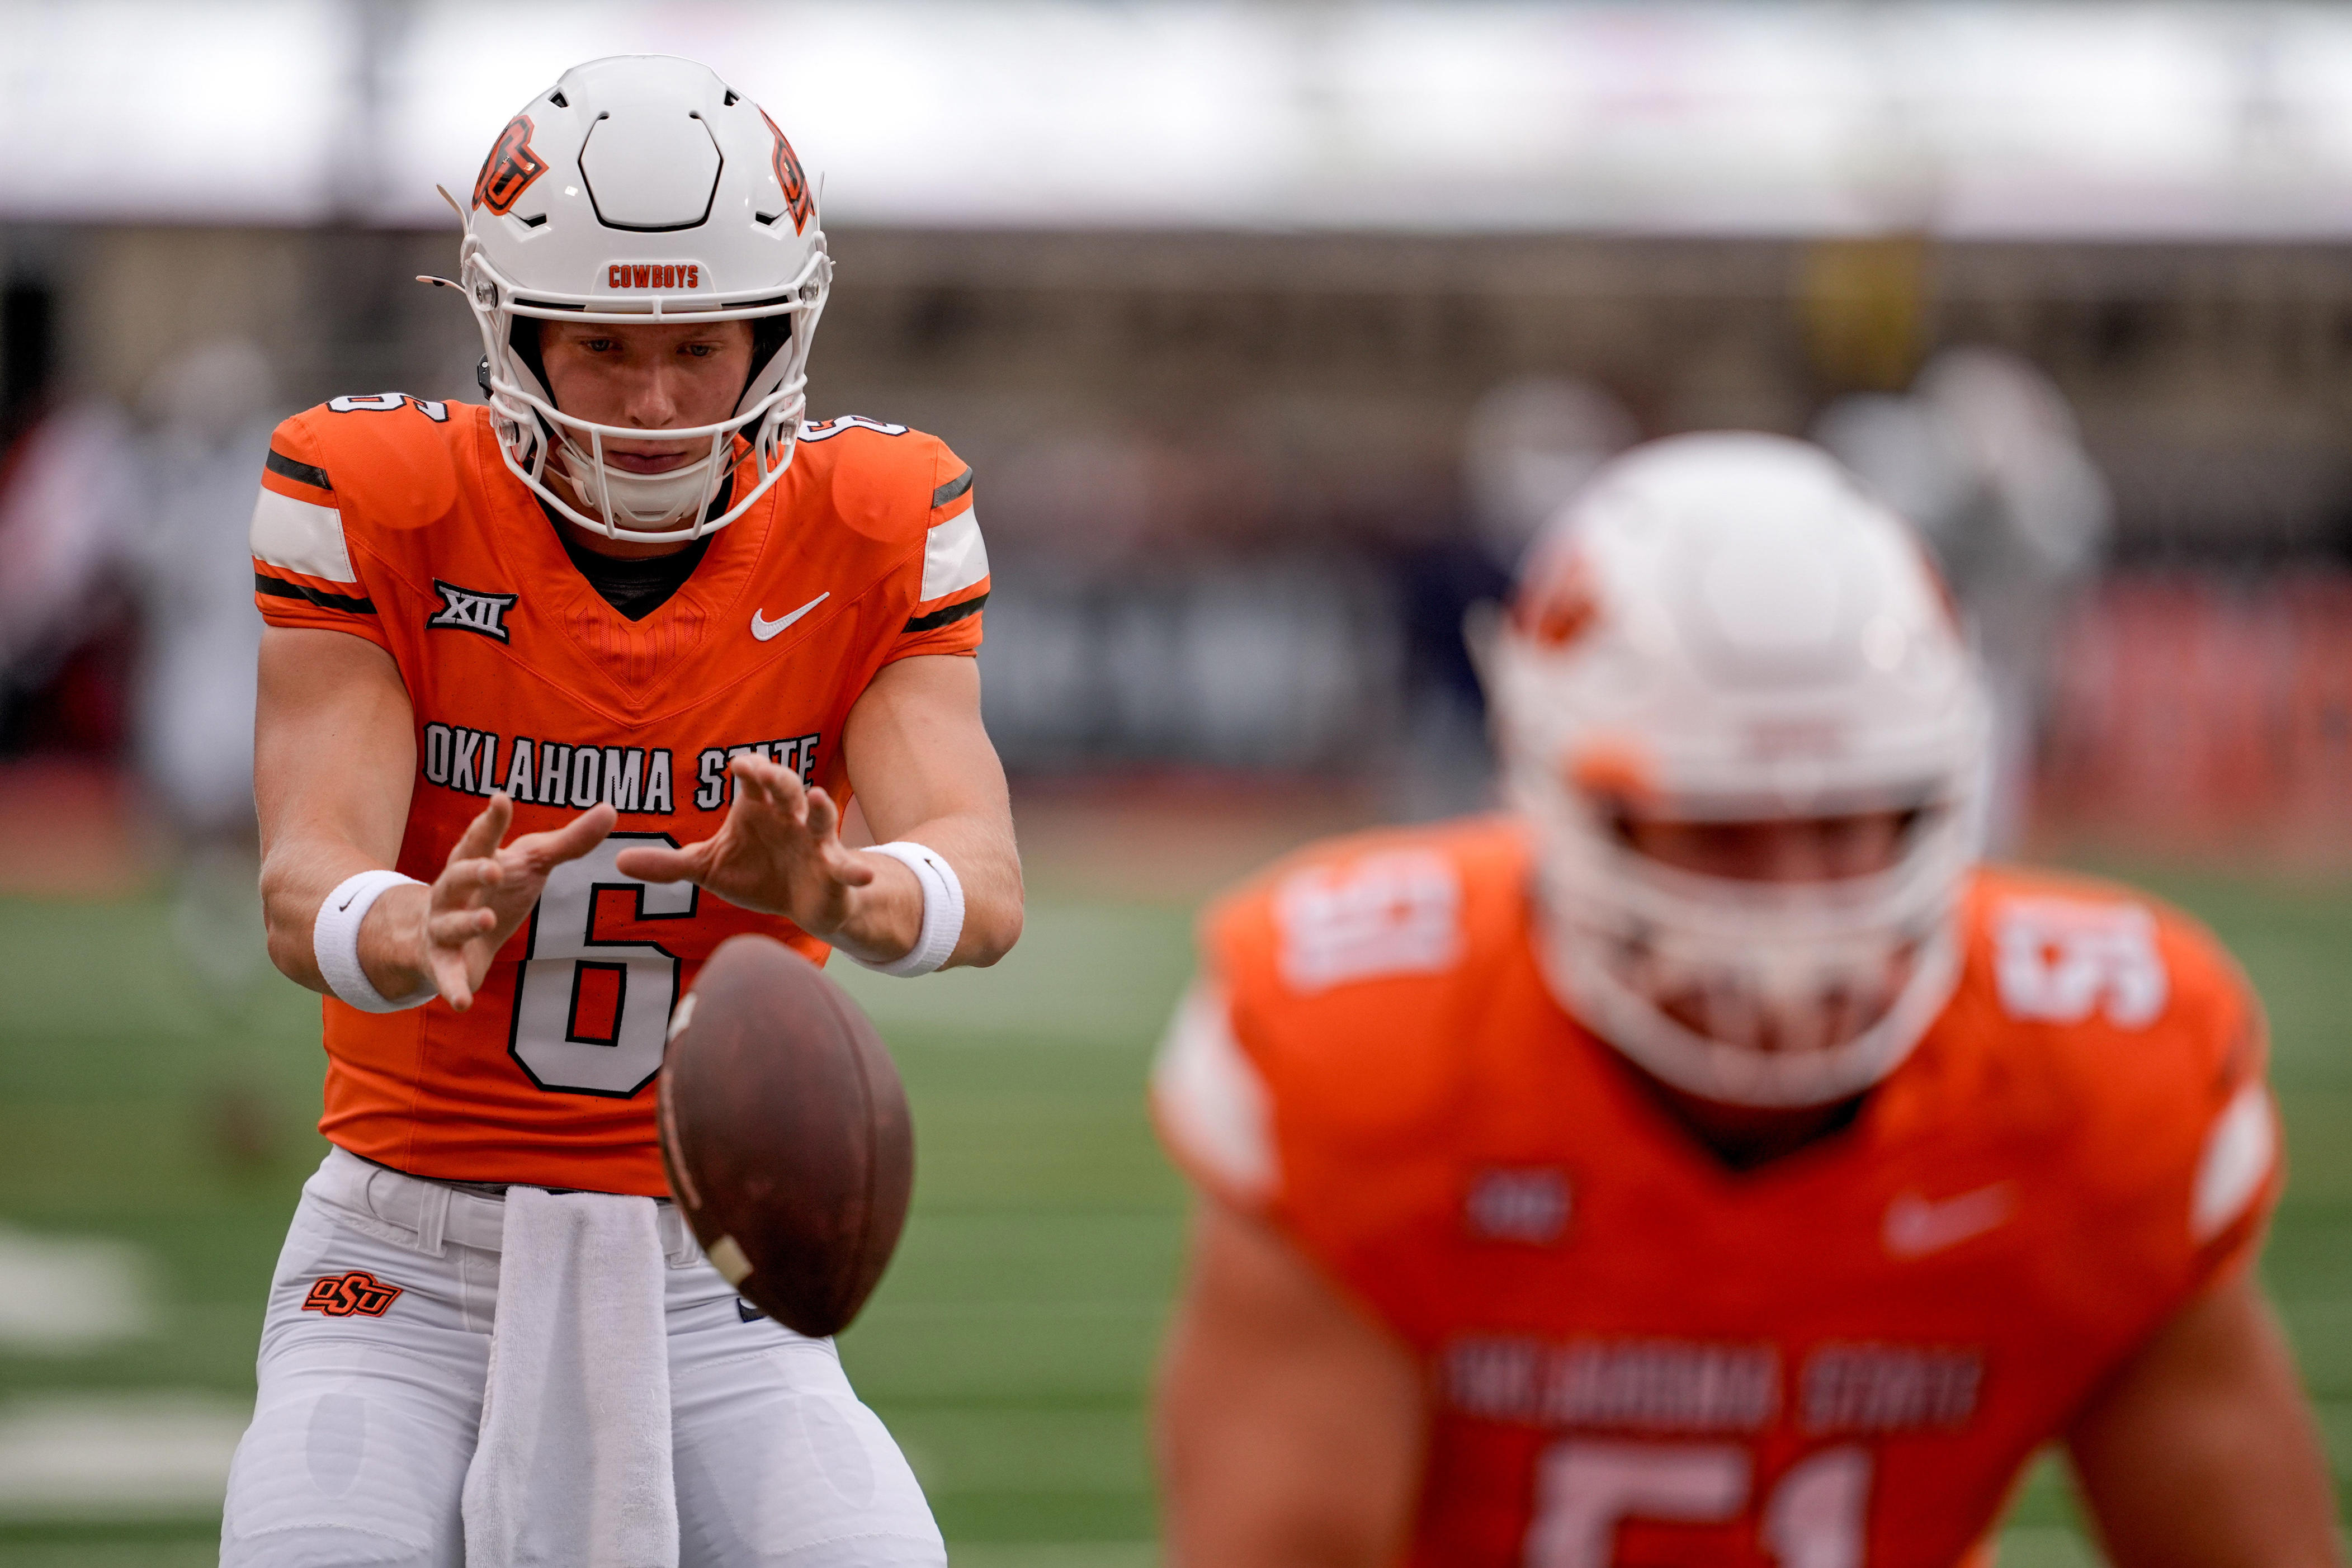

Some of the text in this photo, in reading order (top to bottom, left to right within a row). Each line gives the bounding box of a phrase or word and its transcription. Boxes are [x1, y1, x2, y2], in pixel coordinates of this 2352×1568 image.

[608, 265, 699, 289] COWBOYS
[429, 582, 516, 641] XII
[422, 721, 676, 815] OKLAHOMA
[507, 831, 699, 1099] 6
[301, 1271, 403, 1317] OSU
